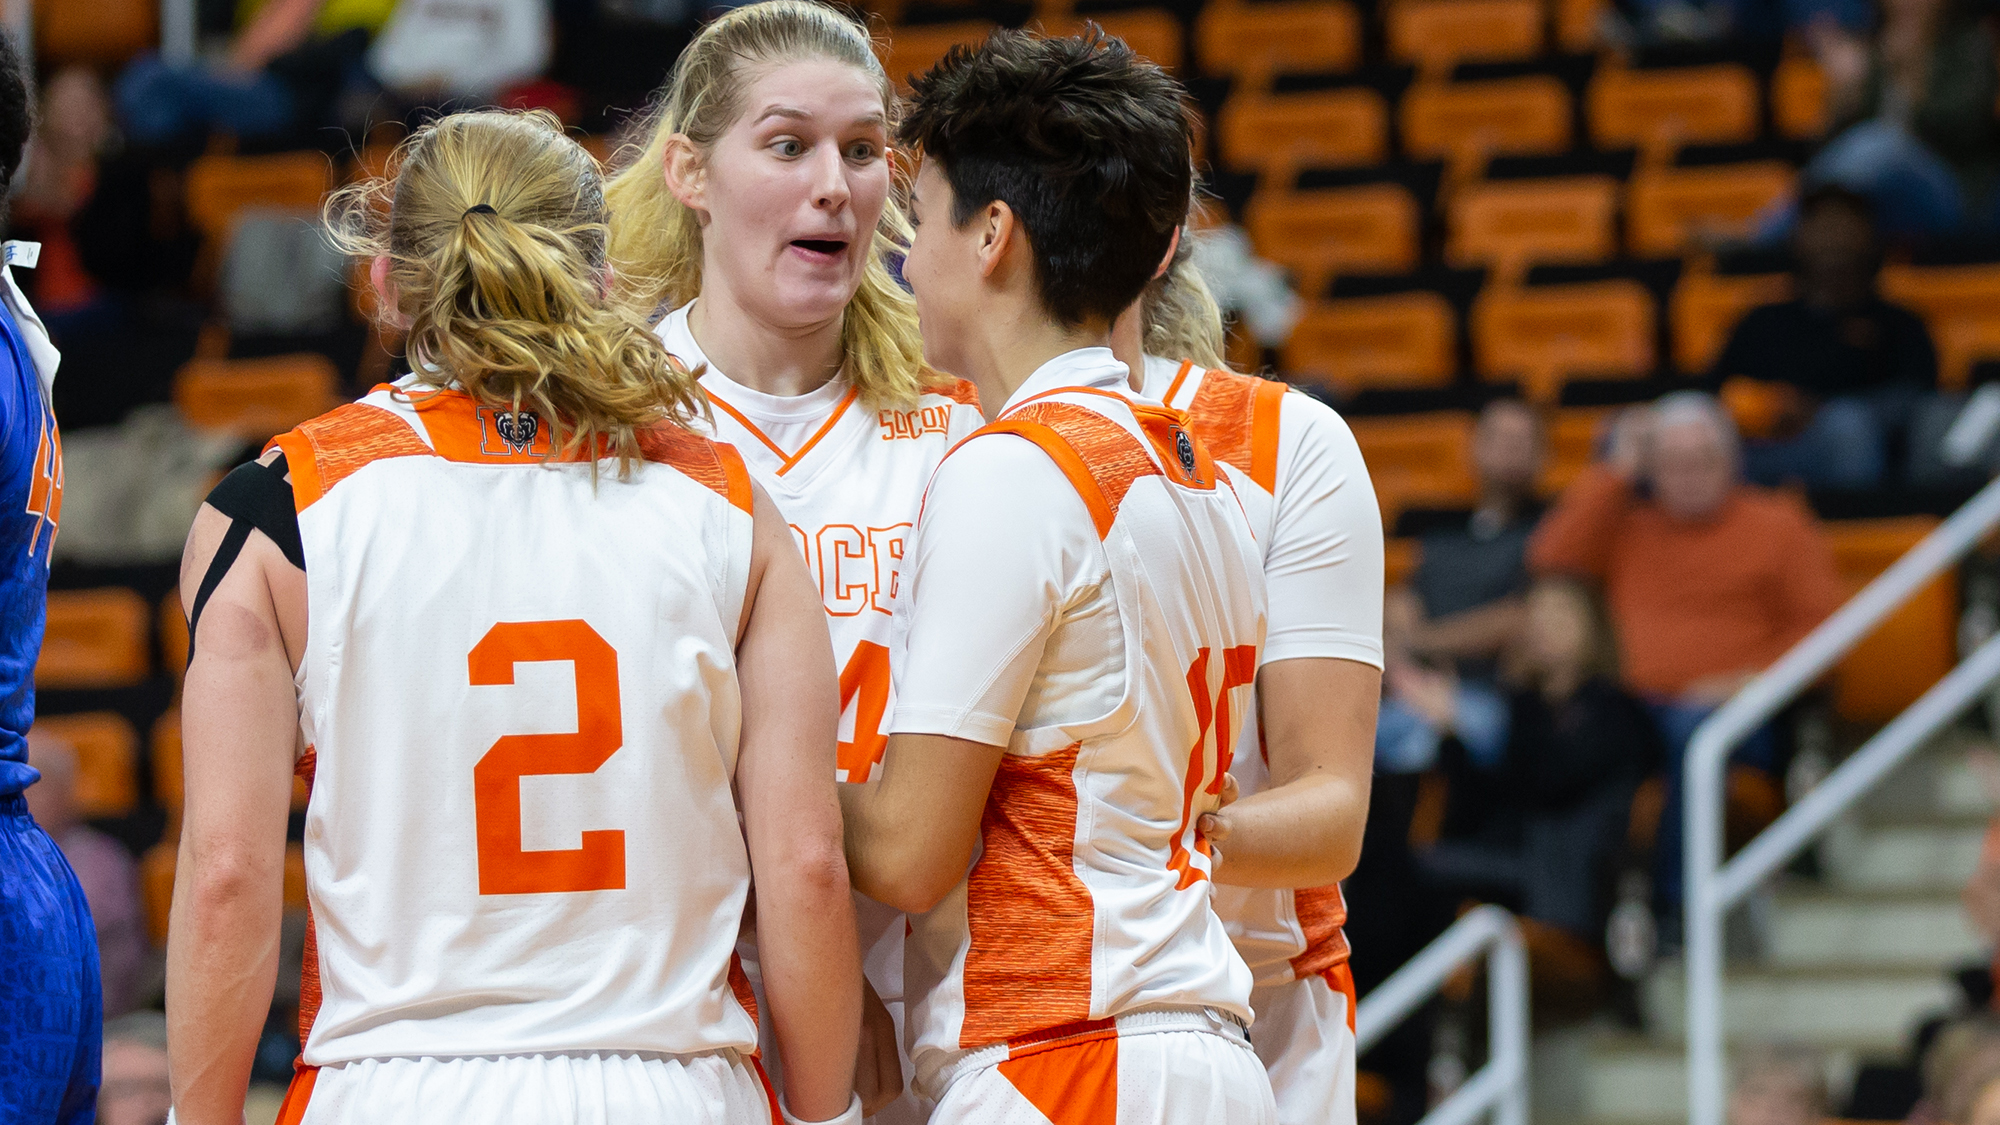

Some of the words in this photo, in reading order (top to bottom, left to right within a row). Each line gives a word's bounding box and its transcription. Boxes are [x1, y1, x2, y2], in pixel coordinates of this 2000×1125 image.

[878, 404, 953, 441] SOCON
[788, 522, 914, 618] CE
[467, 618, 627, 896] 2
[837, 640, 890, 783] 4
